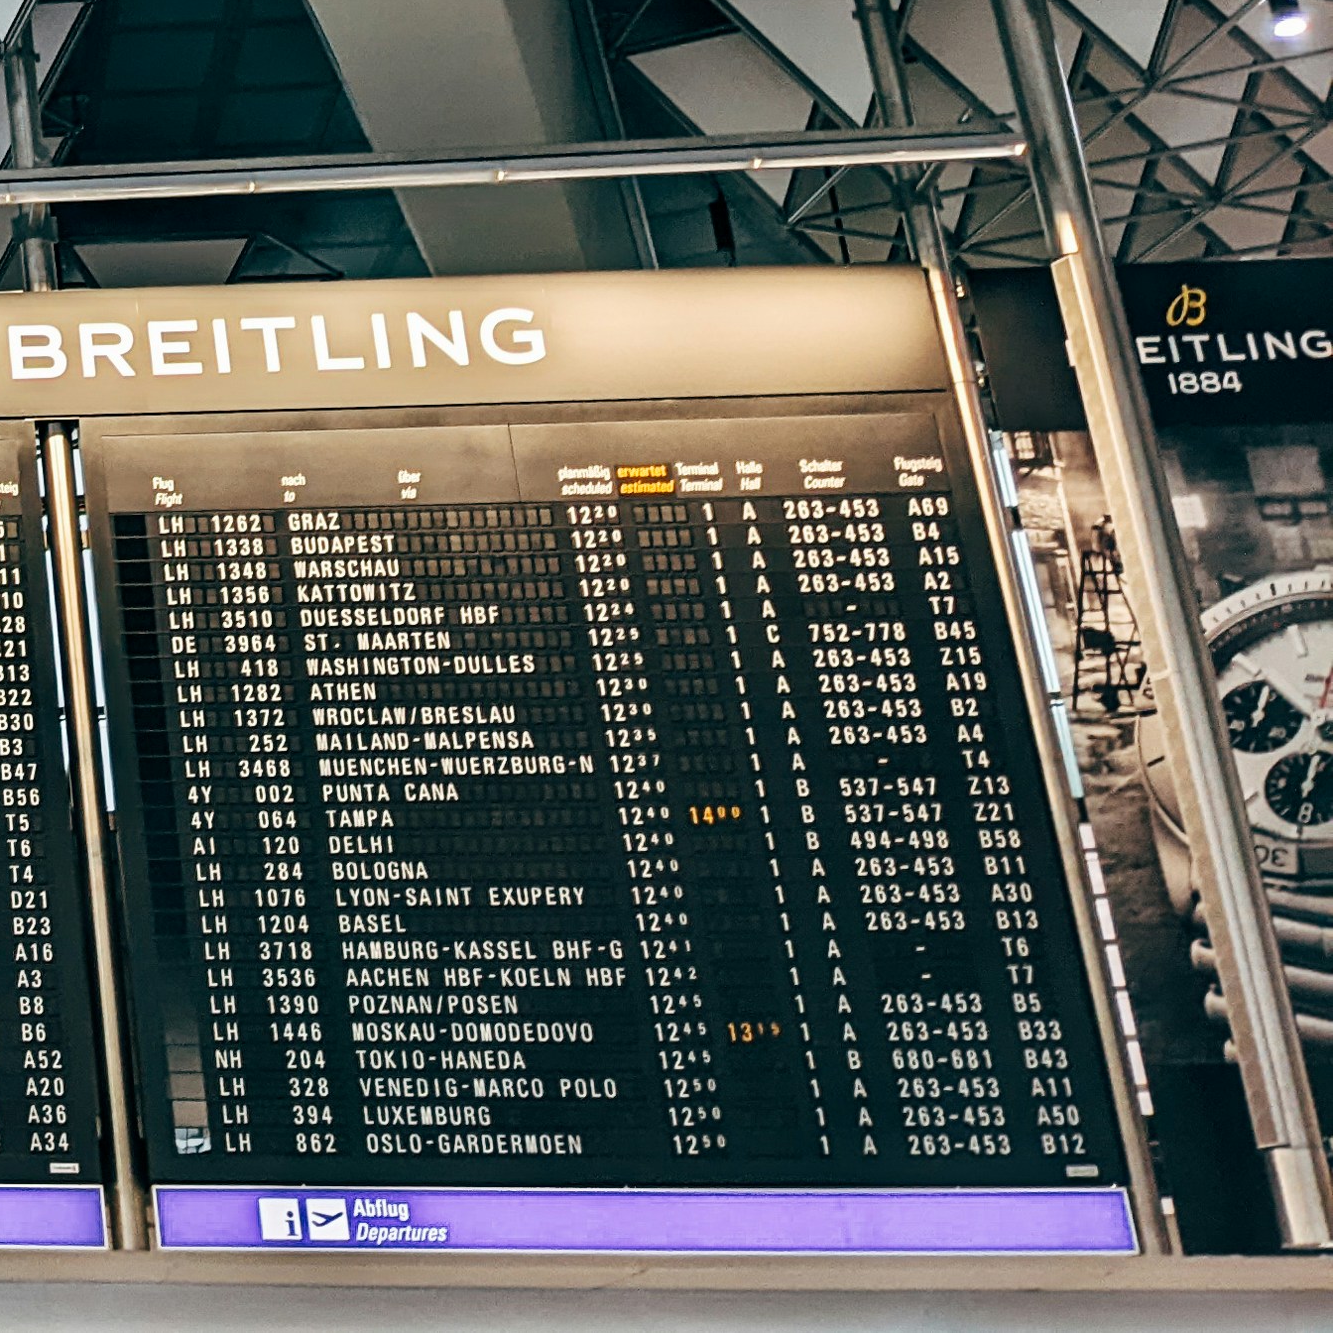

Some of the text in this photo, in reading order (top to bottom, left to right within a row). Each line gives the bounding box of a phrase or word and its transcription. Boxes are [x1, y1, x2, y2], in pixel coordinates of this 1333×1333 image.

[7, 306, 546, 380] BREITLING
[1135, 330, 1333, 364] EITLING
[1168, 371, 1242, 395] 1884
[617, 465, 666, 478] erwartet
[675, 462, 718, 475] Terminal
[152, 477, 174, 491] Flug
[621, 480, 674, 494] estimated
[680, 477, 723, 492] Terminal
[804, 475, 846, 489] Counter
[155, 493, 182, 507] Flight
[159, 497, 949, 534] LH 1262 GRAZ A69
[291, 534, 395, 555] BUDAPEST
[297, 582, 416, 602] KATTOWITZ
[300, 606, 499, 627] DUESSELDORF HBF
[306, 646, 981, 676] WASHINGTON-DULLES Z15
[313, 705, 515, 726] WROCLAW/BRESLAU
[322, 777, 935, 802] PUNTA CANA 537-547
[331, 860, 429, 880] BOLOGNA
[349, 994, 518, 1014] POZNAN/POSEN
[215, 1050, 526, 1070] NH 204 TOKIO-HANEDA
[363, 1105, 491, 1126] LUXEMBURG
[366, 1133, 1085, 1154] OSLO-GARDERMOEN B12
[353, 1199, 409, 1220] Abflug
[355, 1222, 448, 1243] Departures
